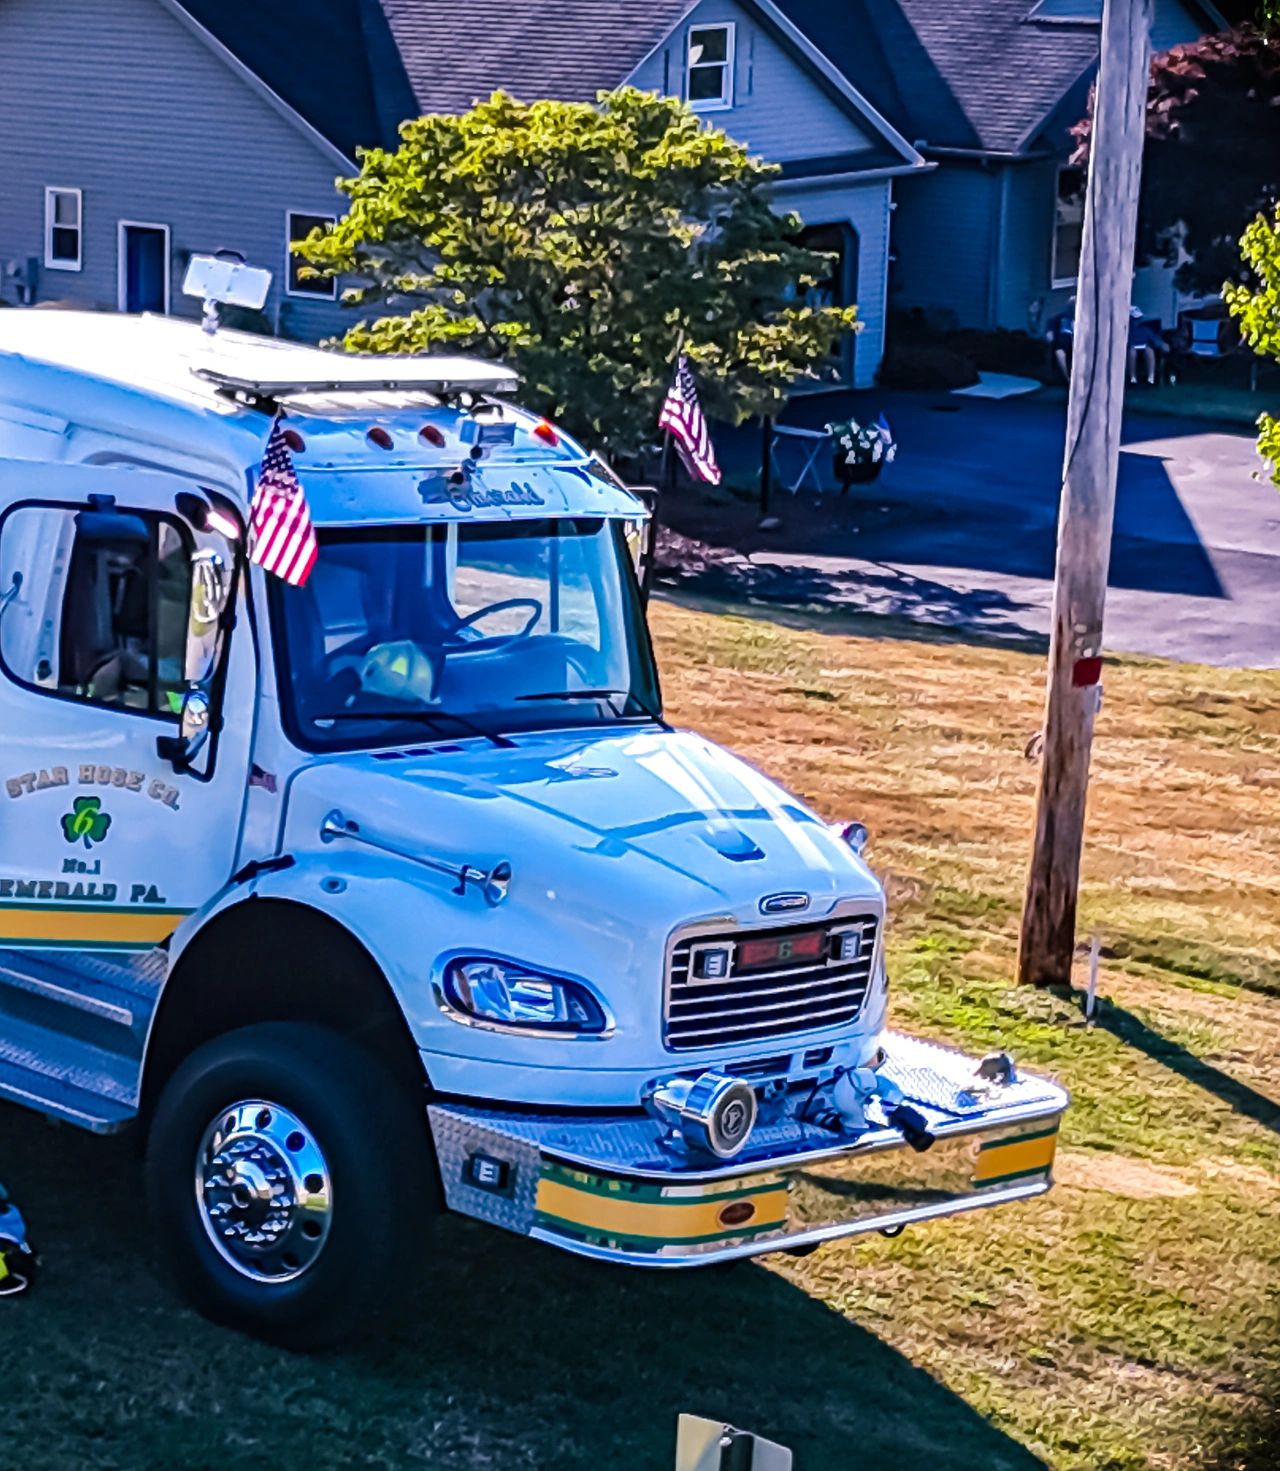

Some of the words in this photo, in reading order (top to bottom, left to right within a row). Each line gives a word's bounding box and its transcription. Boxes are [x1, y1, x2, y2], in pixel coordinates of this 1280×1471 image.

[5, 766, 68, 799] STAR
[78, 764, 146, 792] HOSE
[147, 779, 180, 811] CO.
[73, 807, 97, 835] 6
[130, 884, 166, 903] PA.
